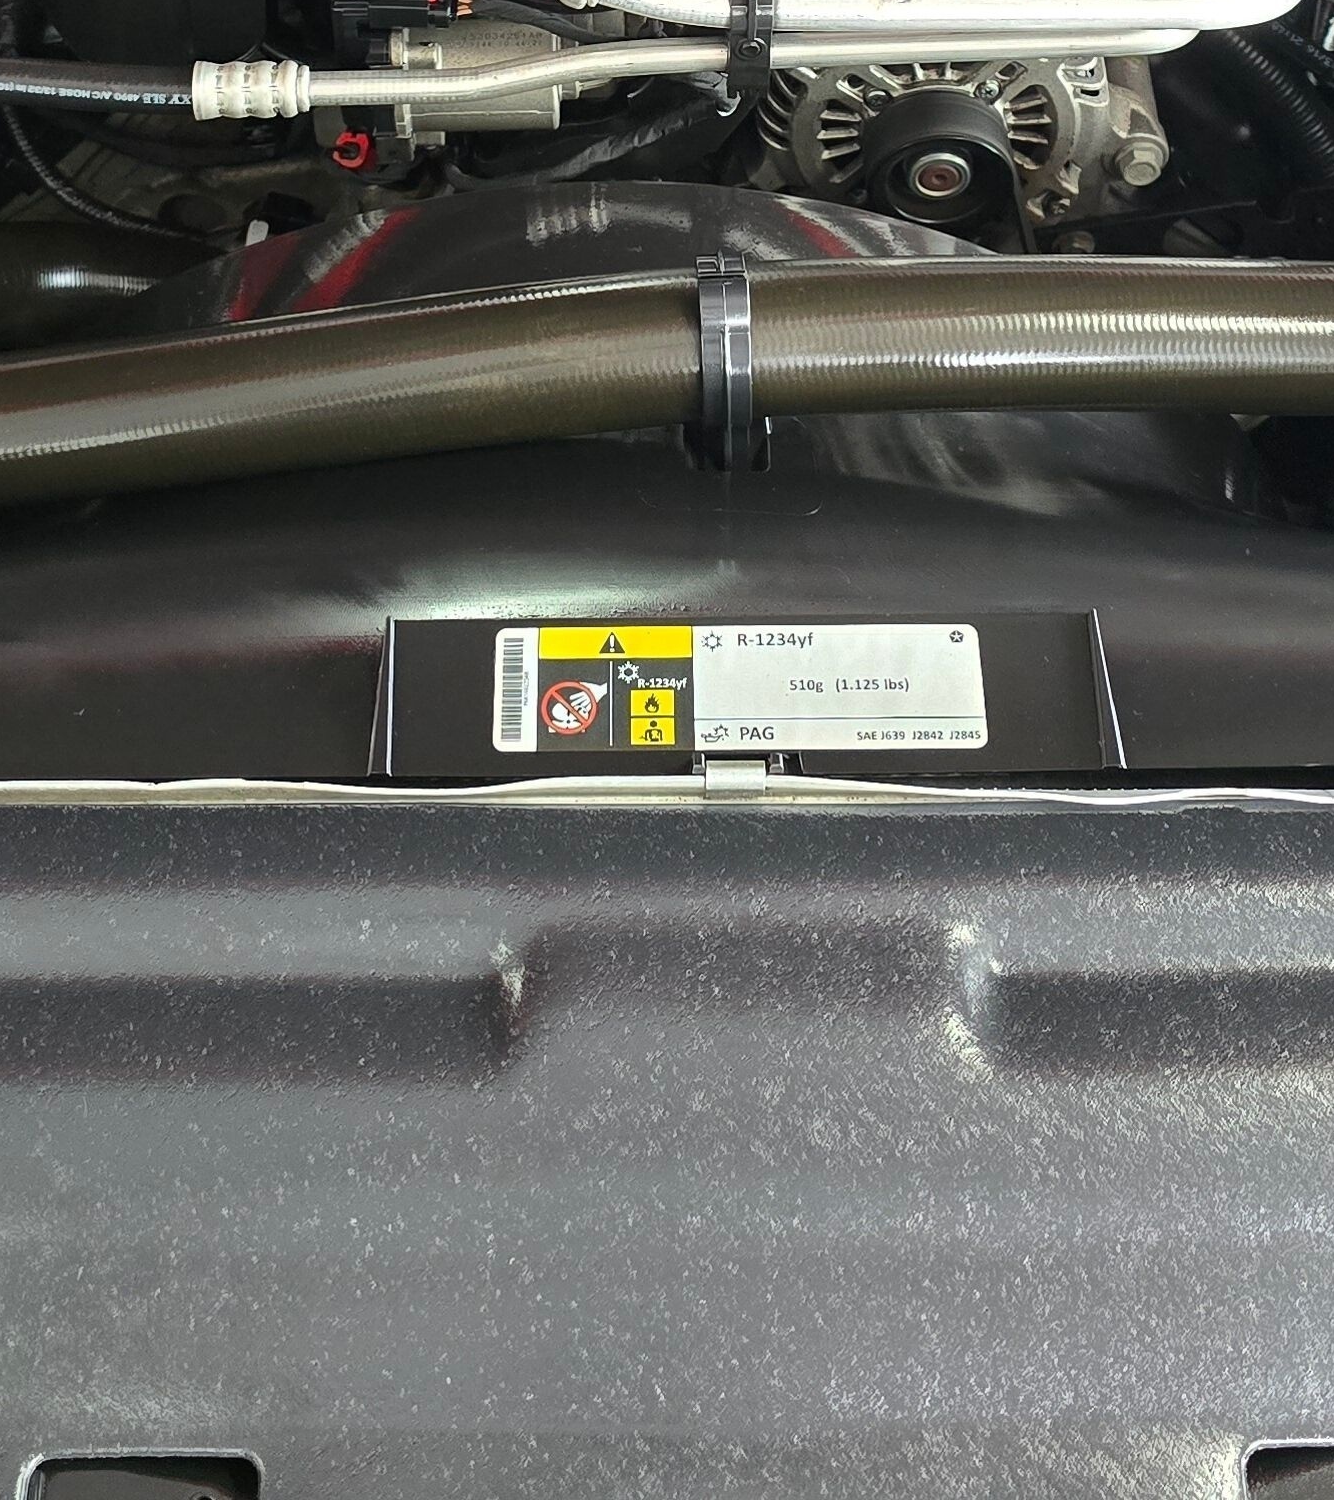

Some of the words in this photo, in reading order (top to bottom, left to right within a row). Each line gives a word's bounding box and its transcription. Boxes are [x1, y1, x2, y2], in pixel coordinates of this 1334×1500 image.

[58, 87, 90, 98] HOSE
[737, 631, 814, 650] R-1234yf
[636, 676, 688, 690] R-1234yf
[789, 677, 825, 695] 510g
[835, 676, 878, 694] (1.125
[882, 676, 910, 694] lbs)
[740, 725, 775, 742] PAG
[856, 731, 878, 741] SAE
[880, 730, 906, 741] J639
[911, 730, 944, 741] J2842
[949, 730, 982, 741] J2845
